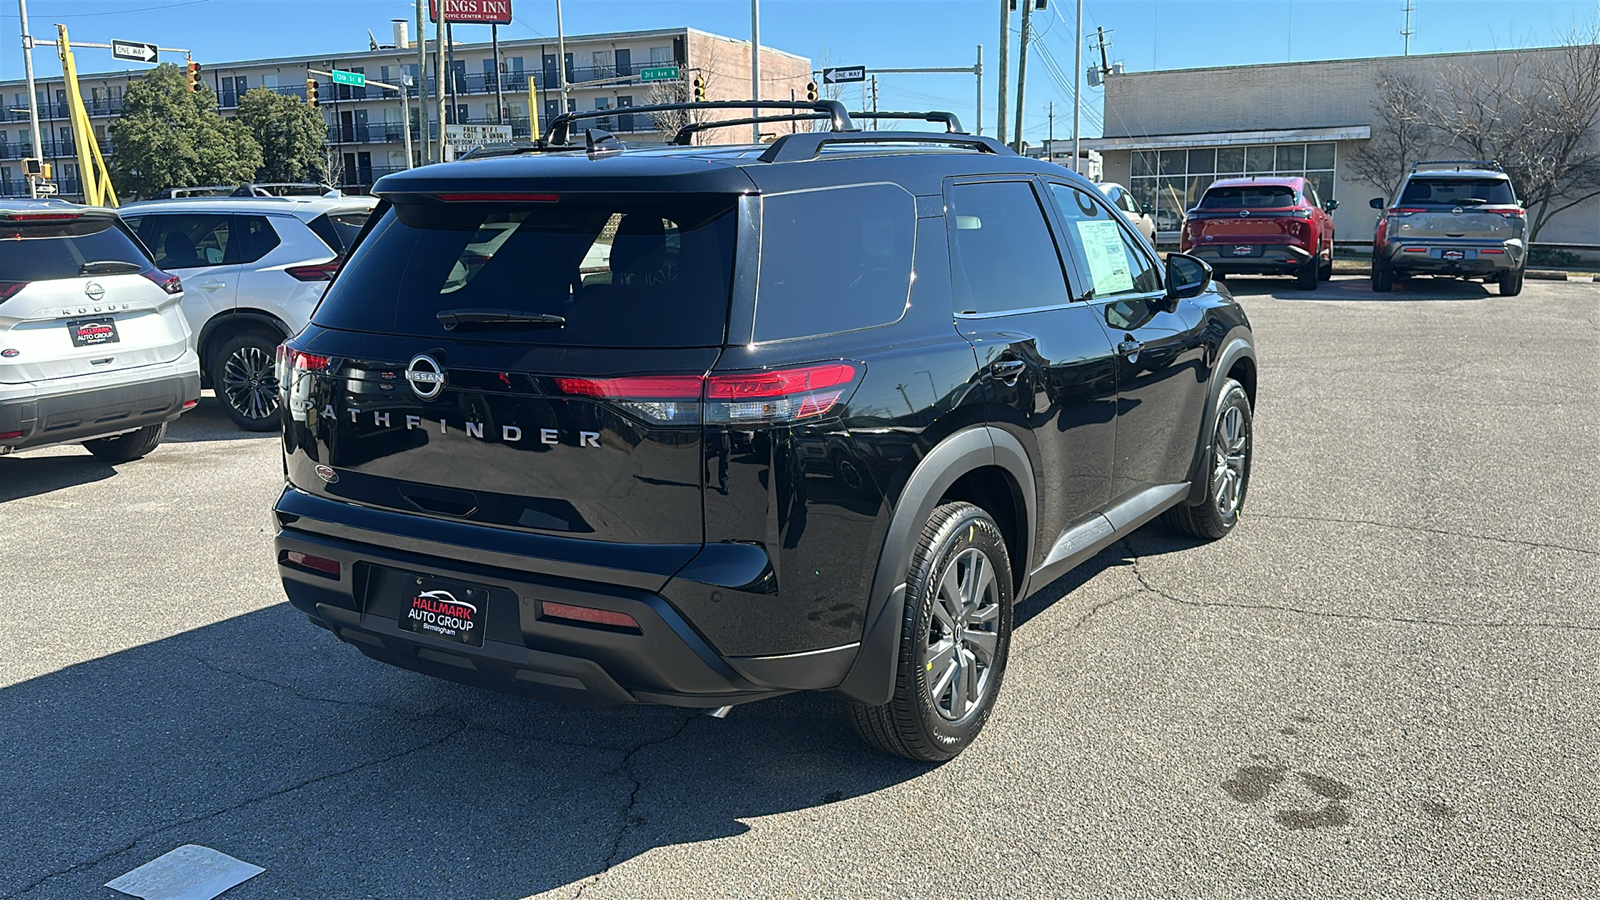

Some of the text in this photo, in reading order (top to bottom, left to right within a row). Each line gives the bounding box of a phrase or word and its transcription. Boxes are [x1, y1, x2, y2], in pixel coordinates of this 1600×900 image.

[434, 0, 506, 13] INGS INN
[117, 46, 145, 55] ONE WAY
[848, 69, 860, 77] WAY
[62, 303, 129, 315] ROGUE
[77, 327, 111, 336] HALLMARK
[77, 333, 94, 342] AUTO
[94, 331, 114, 339] GROUP
[405, 370, 444, 384] NISSAN
[302, 399, 601, 448] PATHFINDER
[412, 596, 472, 620] HALLMARK
[407, 608, 474, 631] AUTO GROUP
[423, 622, 456, 636] Birmingham
